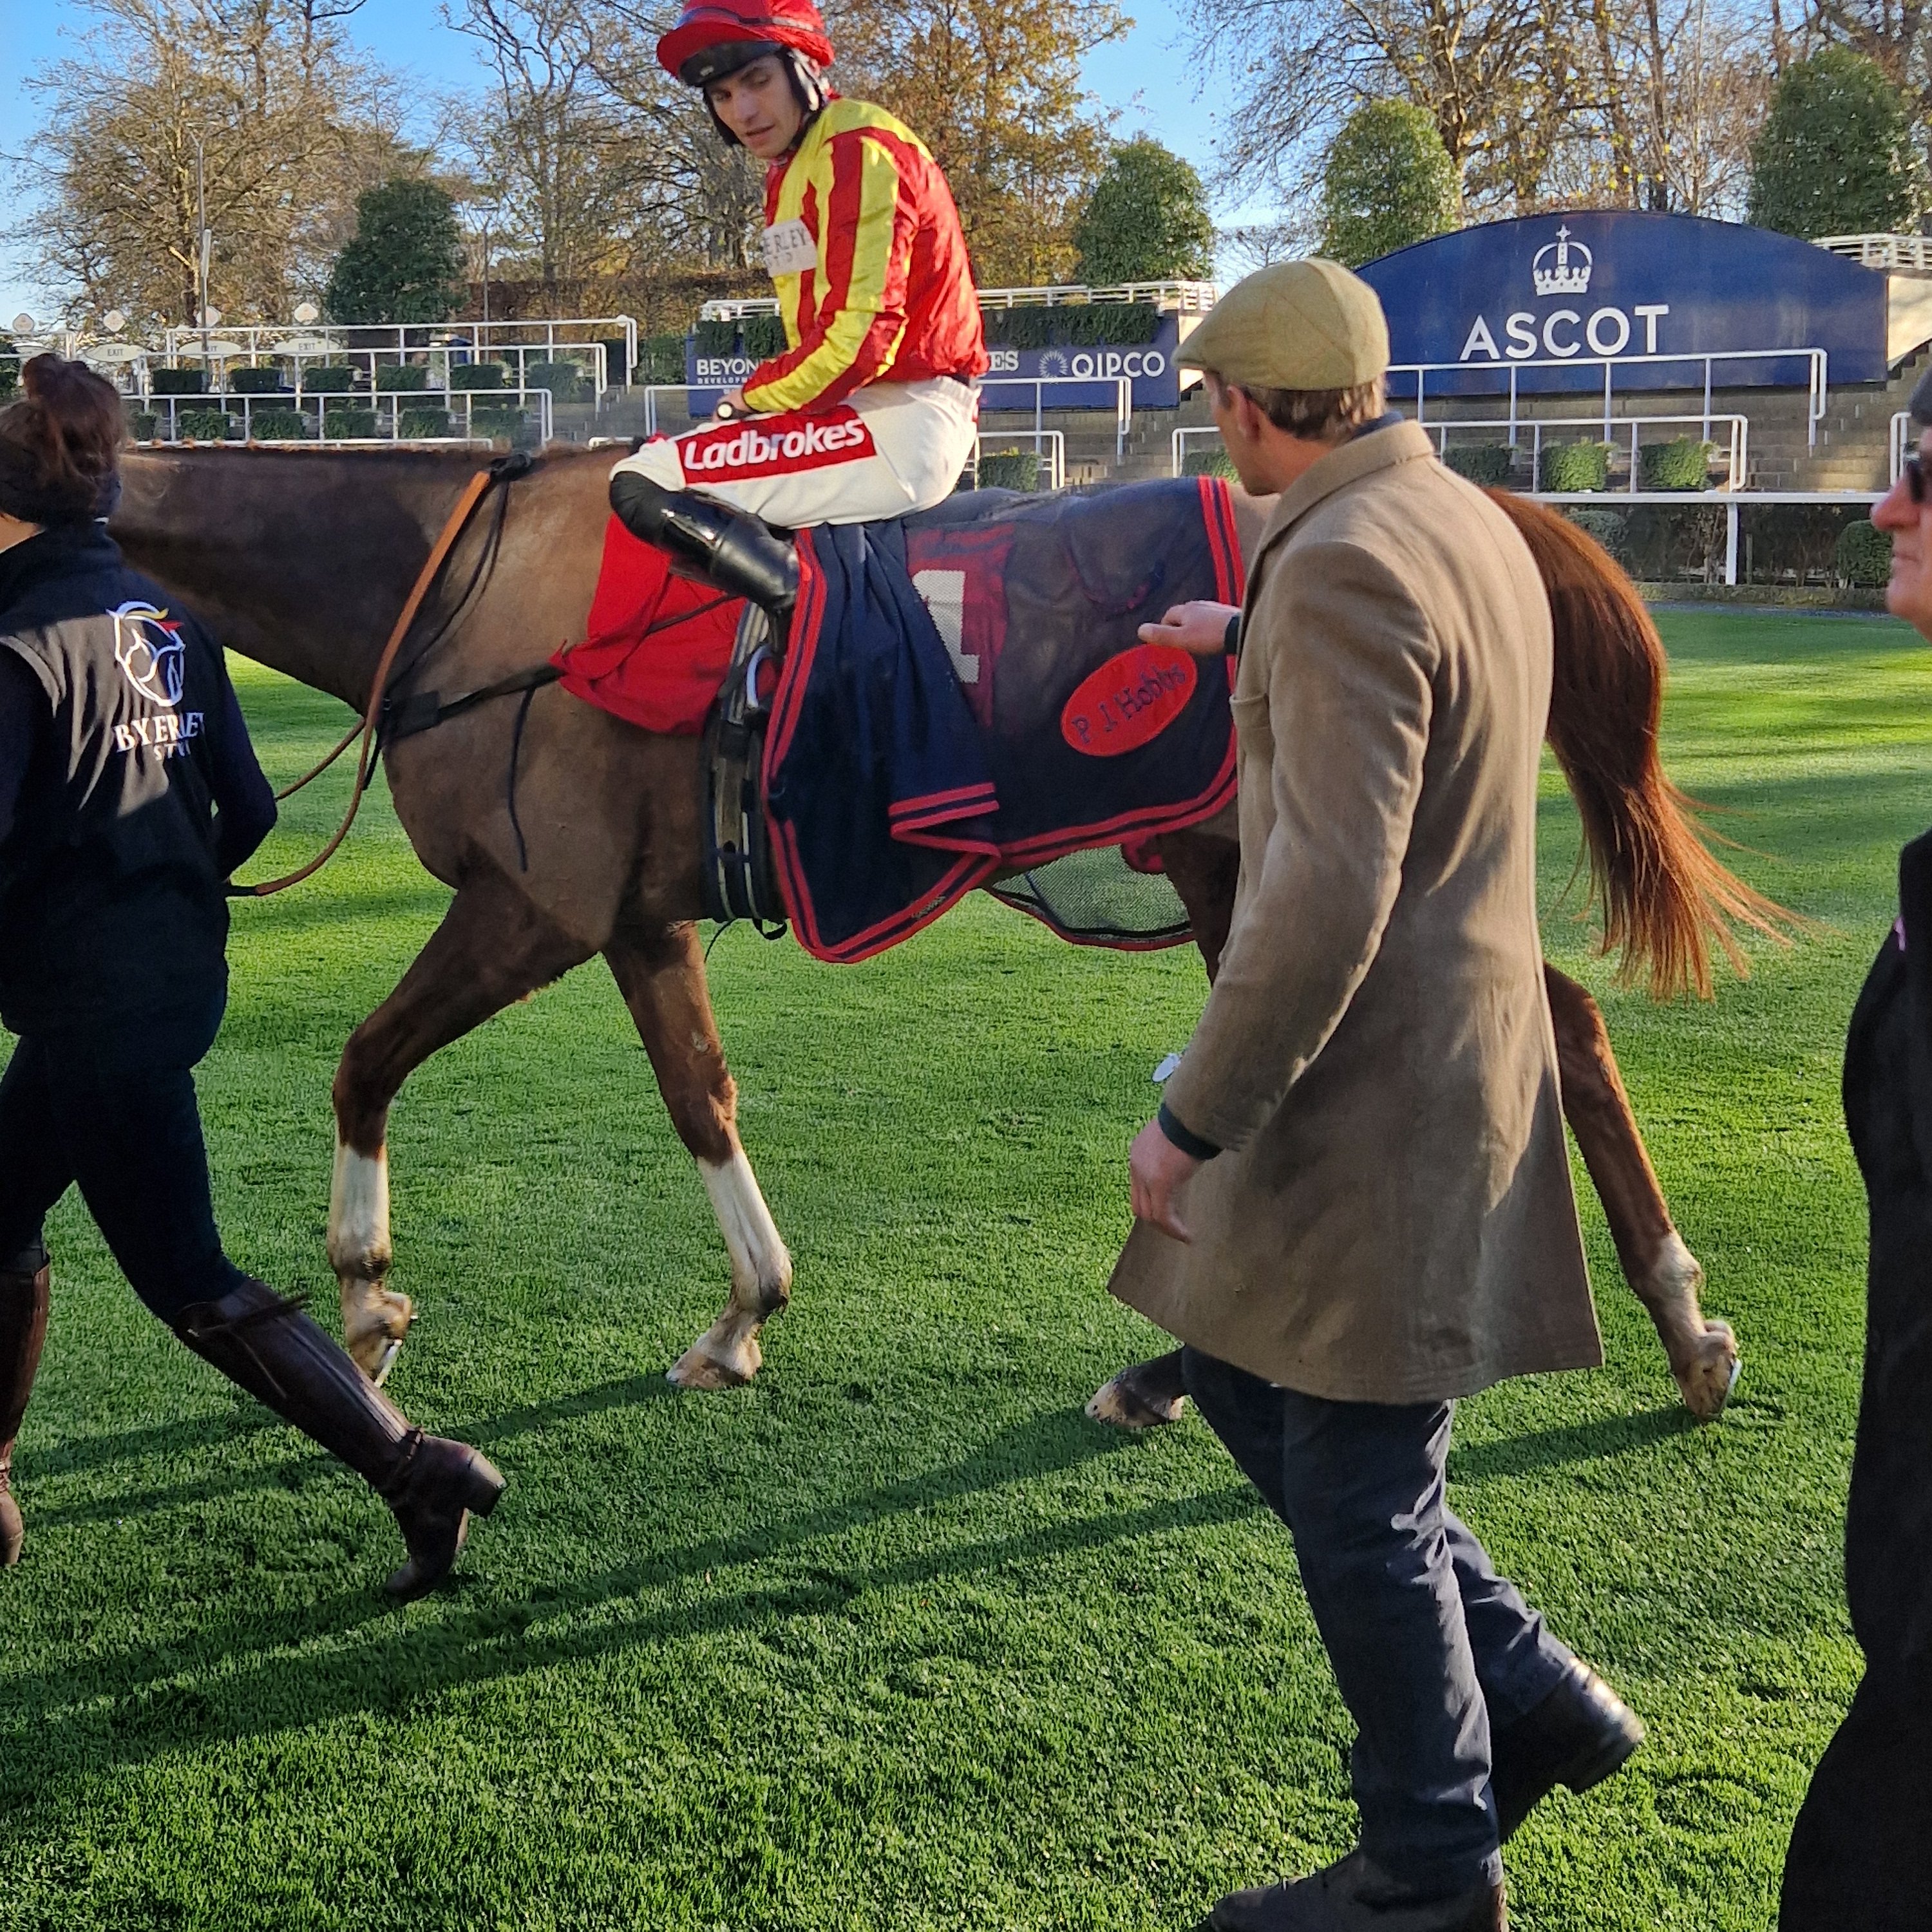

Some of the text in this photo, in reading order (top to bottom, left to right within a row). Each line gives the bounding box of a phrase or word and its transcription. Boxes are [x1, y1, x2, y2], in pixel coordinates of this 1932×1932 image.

[1459, 304, 1670, 361] ASCOT
[107, 348, 124, 357] EXIT
[298, 343, 316, 351] EXIT
[696, 358, 765, 375] BEYON
[1071, 351, 1166, 378] QIPCO
[684, 420, 865, 470] Ladbrokes
